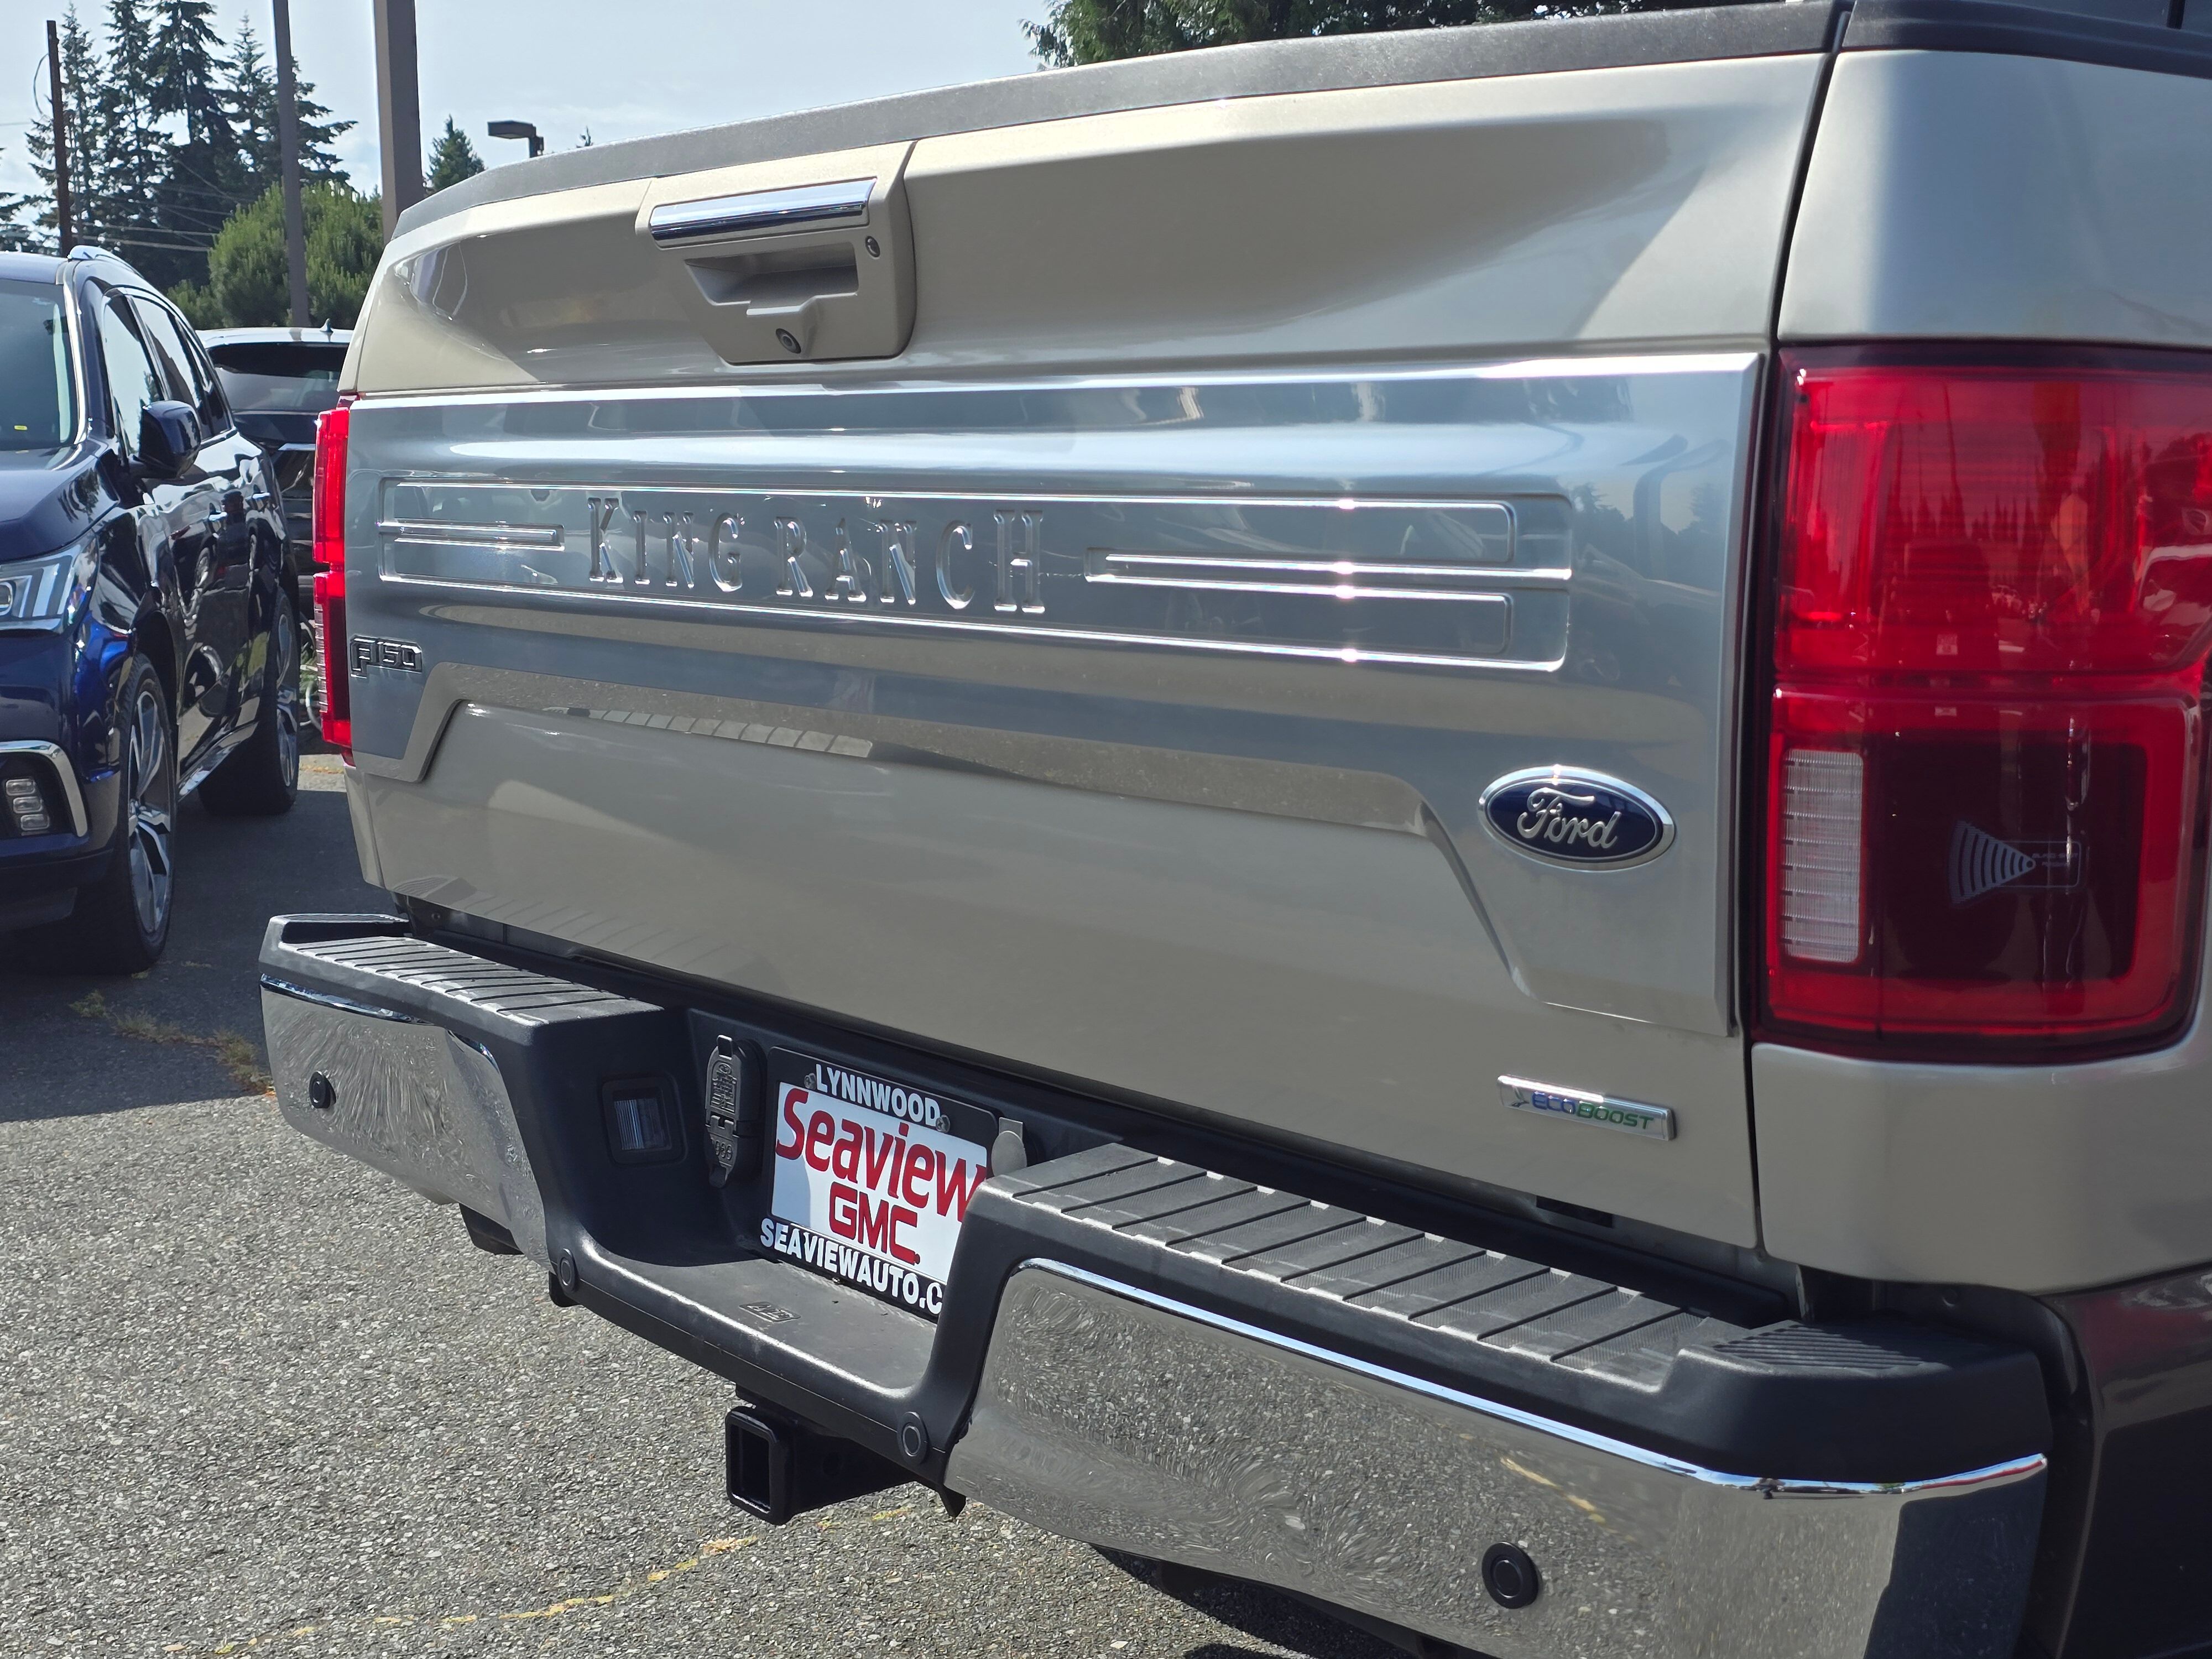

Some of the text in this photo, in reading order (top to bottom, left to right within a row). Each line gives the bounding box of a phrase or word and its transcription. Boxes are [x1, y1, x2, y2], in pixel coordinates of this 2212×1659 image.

[587, 497, 1046, 614] KING RANCH
[1516, 786, 1623, 849] Ford
[815, 1063, 941, 1127] LYNNWOOD
[774, 1087, 987, 1223] Seaview
[828, 1181, 919, 1266] GMC
